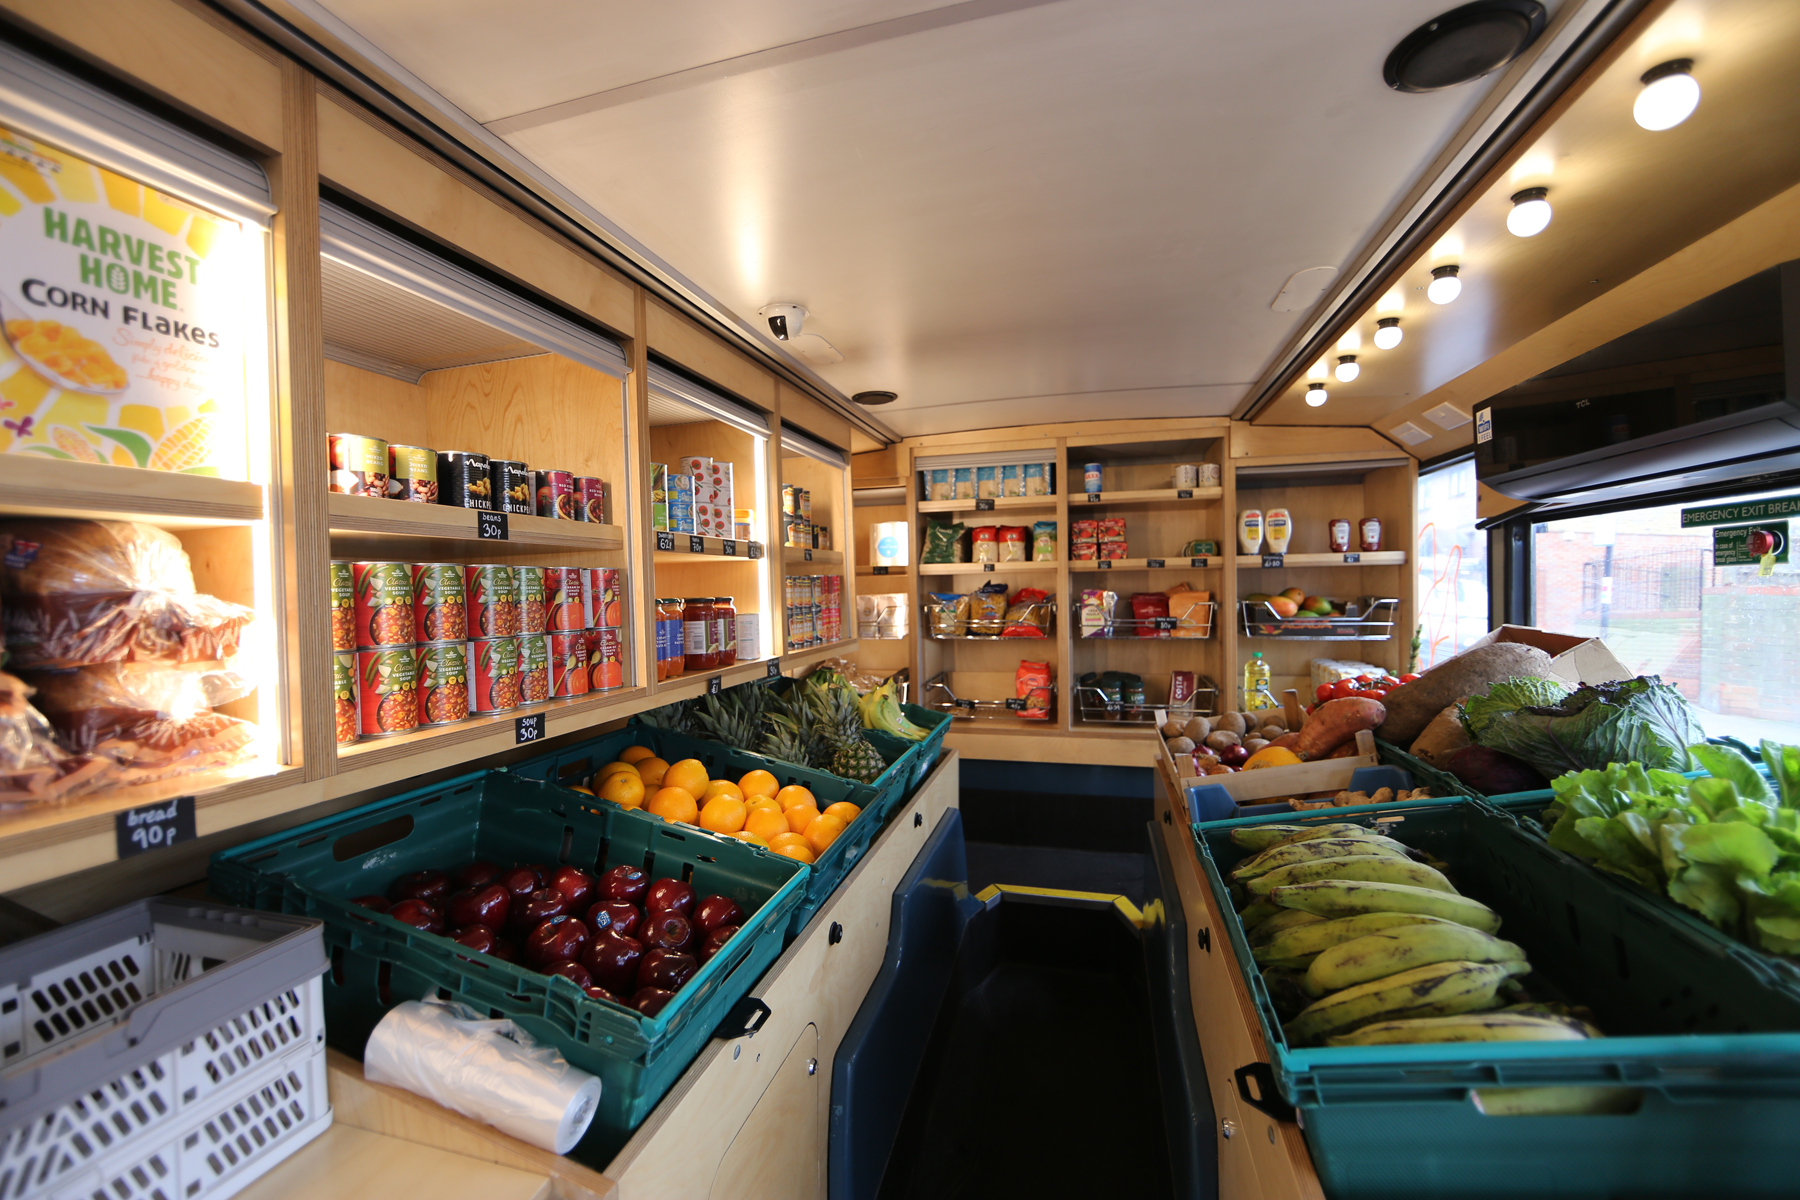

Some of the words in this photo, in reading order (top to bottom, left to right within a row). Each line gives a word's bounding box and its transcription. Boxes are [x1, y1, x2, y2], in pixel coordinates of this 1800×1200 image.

[43, 206, 200, 285] HARVEST
[80, 253, 178, 310] HOME
[21, 278, 109, 319] CORN
[163, 344, 210, 363] delicio
[1576, 399, 1590, 408] TCL
[1481, 432, 1492, 441] FEEL
[482, 513, 501, 522] beans
[1682, 508, 1739, 523] EMERGENCY
[1742, 505, 1765, 517] EXIT
[482, 523, 502, 540] 30p
[1715, 529, 1747, 539] Emergency
[386, 577, 408, 586] Classic
[438, 577, 459, 586] Classic
[394, 663, 414, 673] Classic
[440, 658, 461, 667] Classic
[1175, 676, 1183, 699] COSTA
[521, 716, 537, 727] soup
[520, 728, 538, 741] 30p
[127, 799, 178, 827] bread
[131, 825, 177, 849] 90p
